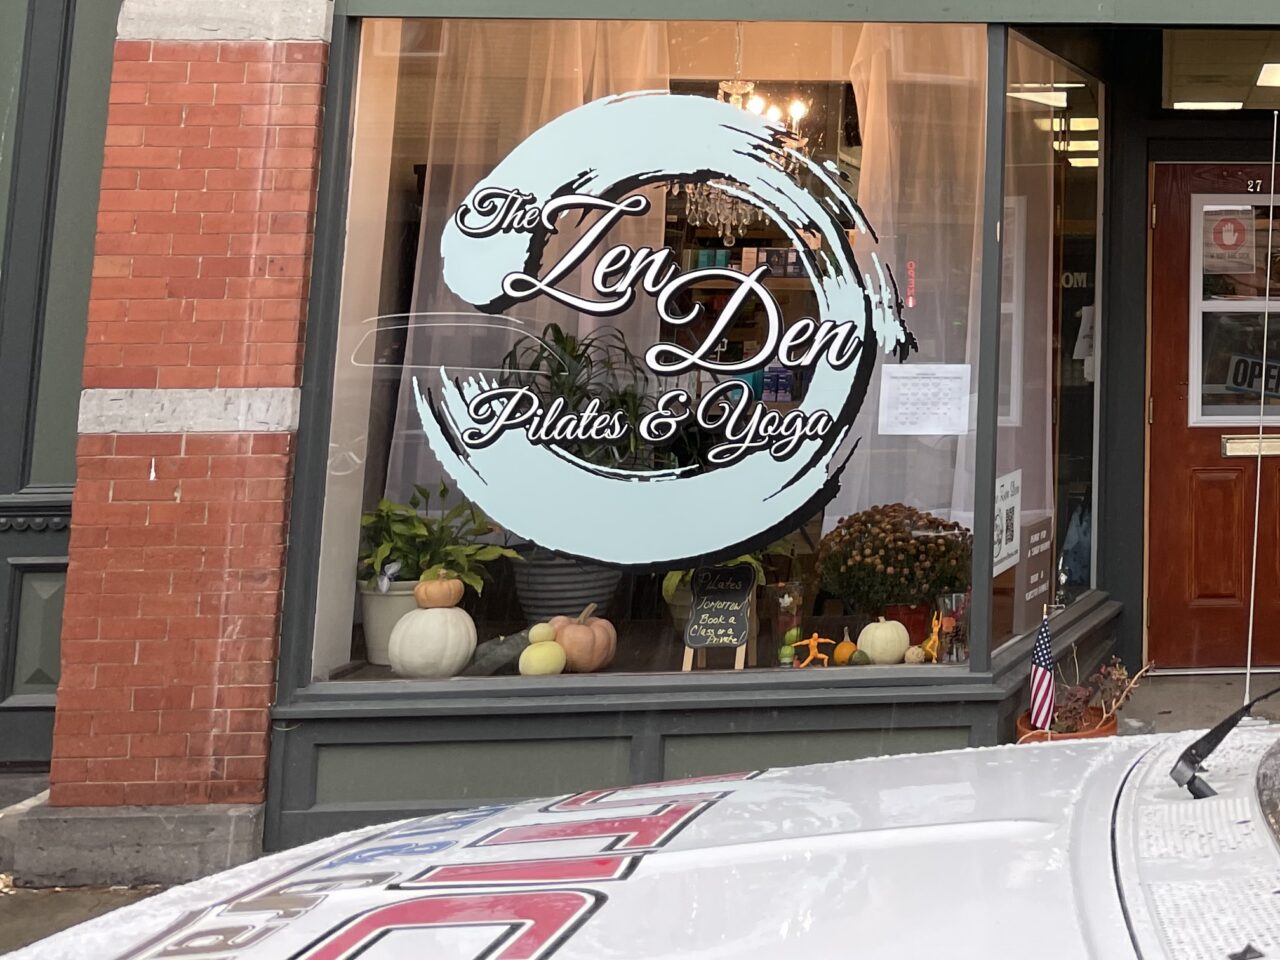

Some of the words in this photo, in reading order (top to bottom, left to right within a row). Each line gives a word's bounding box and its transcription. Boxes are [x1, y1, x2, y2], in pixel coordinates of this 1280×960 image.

[1247, 180, 1263, 193] 27
[455, 187, 542, 235] The
[500, 192, 676, 313] Zen
[644, 264, 866, 374] Den
[462, 386, 629, 444] Pilates
[640, 389, 690, 442] &
[697, 380, 834, 465] Yoga
[689, 624, 715, 637] Class
[699, 613, 726, 625] Book
[728, 616, 737, 625] a
